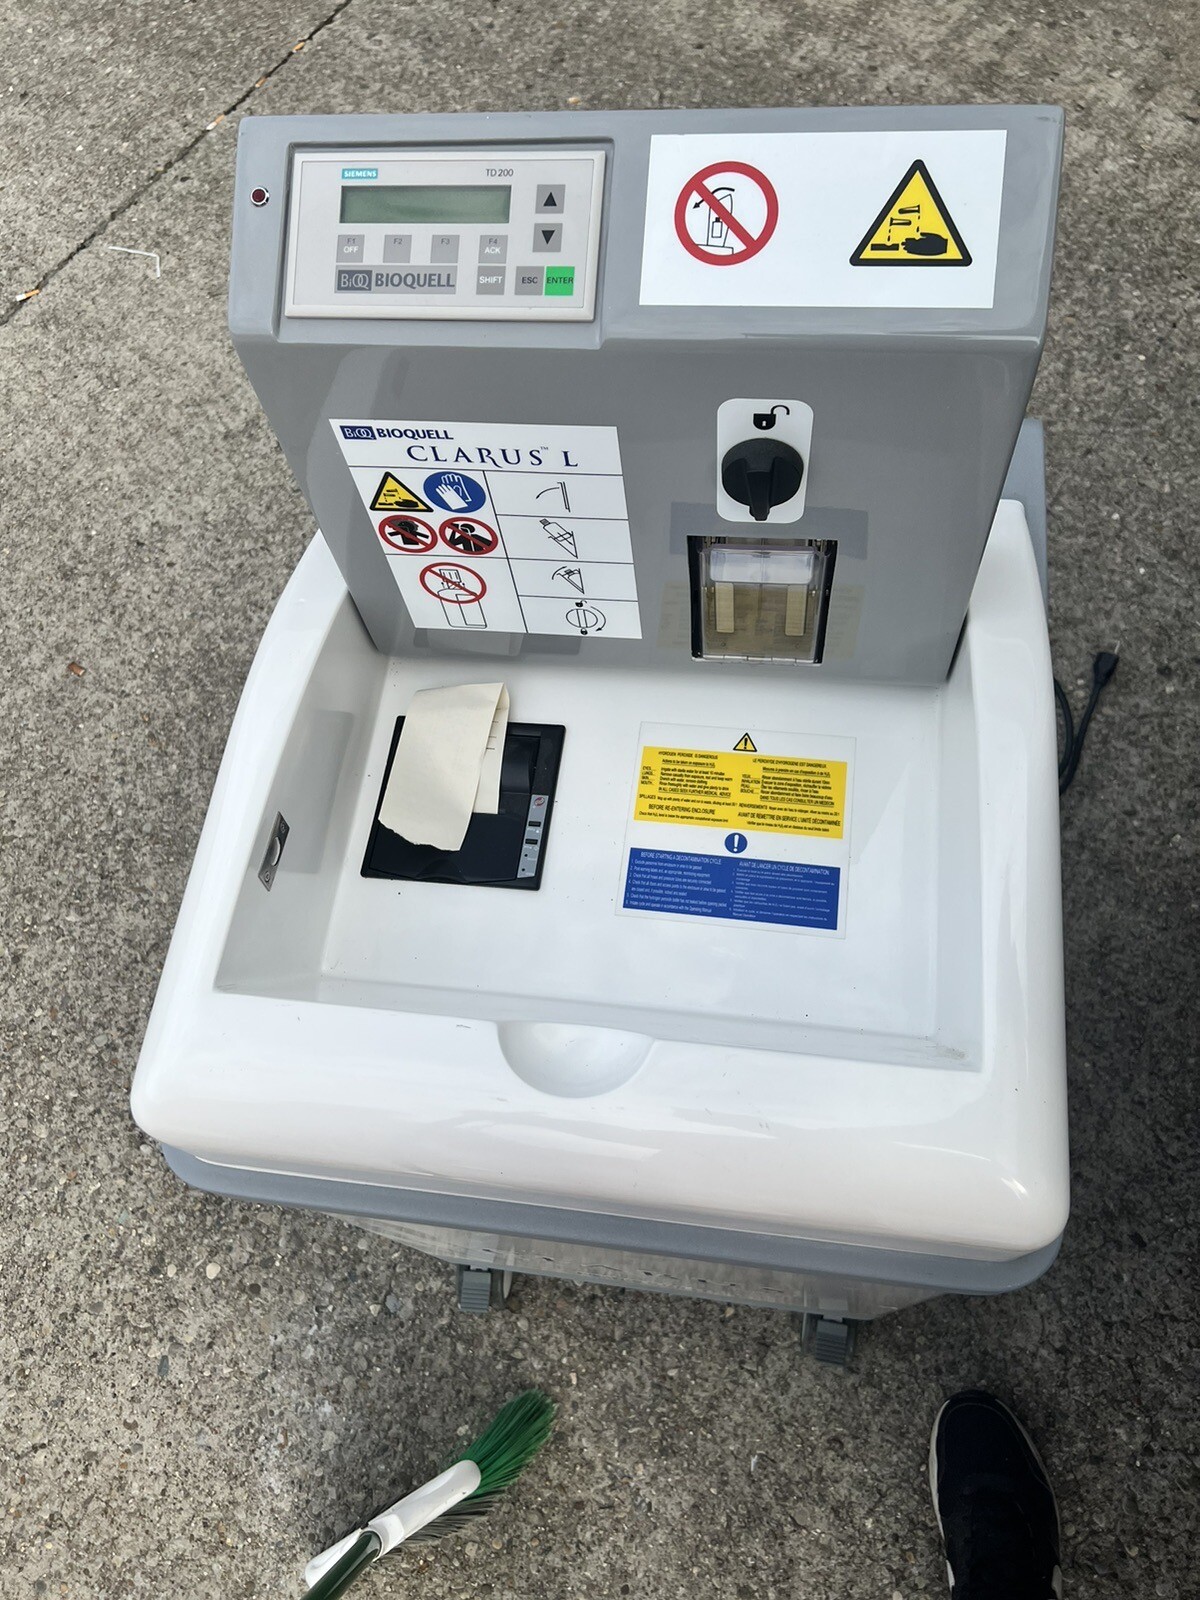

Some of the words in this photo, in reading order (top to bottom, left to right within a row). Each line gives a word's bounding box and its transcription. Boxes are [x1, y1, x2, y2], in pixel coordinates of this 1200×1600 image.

[344, 169, 377, 178] SIEMENS
[486, 168, 497, 177] TD
[498, 168, 514, 177] 200
[346, 237, 356, 245] F1
[343, 246, 359, 254] OFF
[484, 246, 501, 255] ACK
[375, 272, 455, 288] BIOQUELL
[479, 276, 502, 284] SHIFT
[521, 276, 538, 284] ESC
[546, 276, 574, 285] ENTER
[376, 427, 454, 440] BIOQUELL
[563, 450, 579, 468] L
